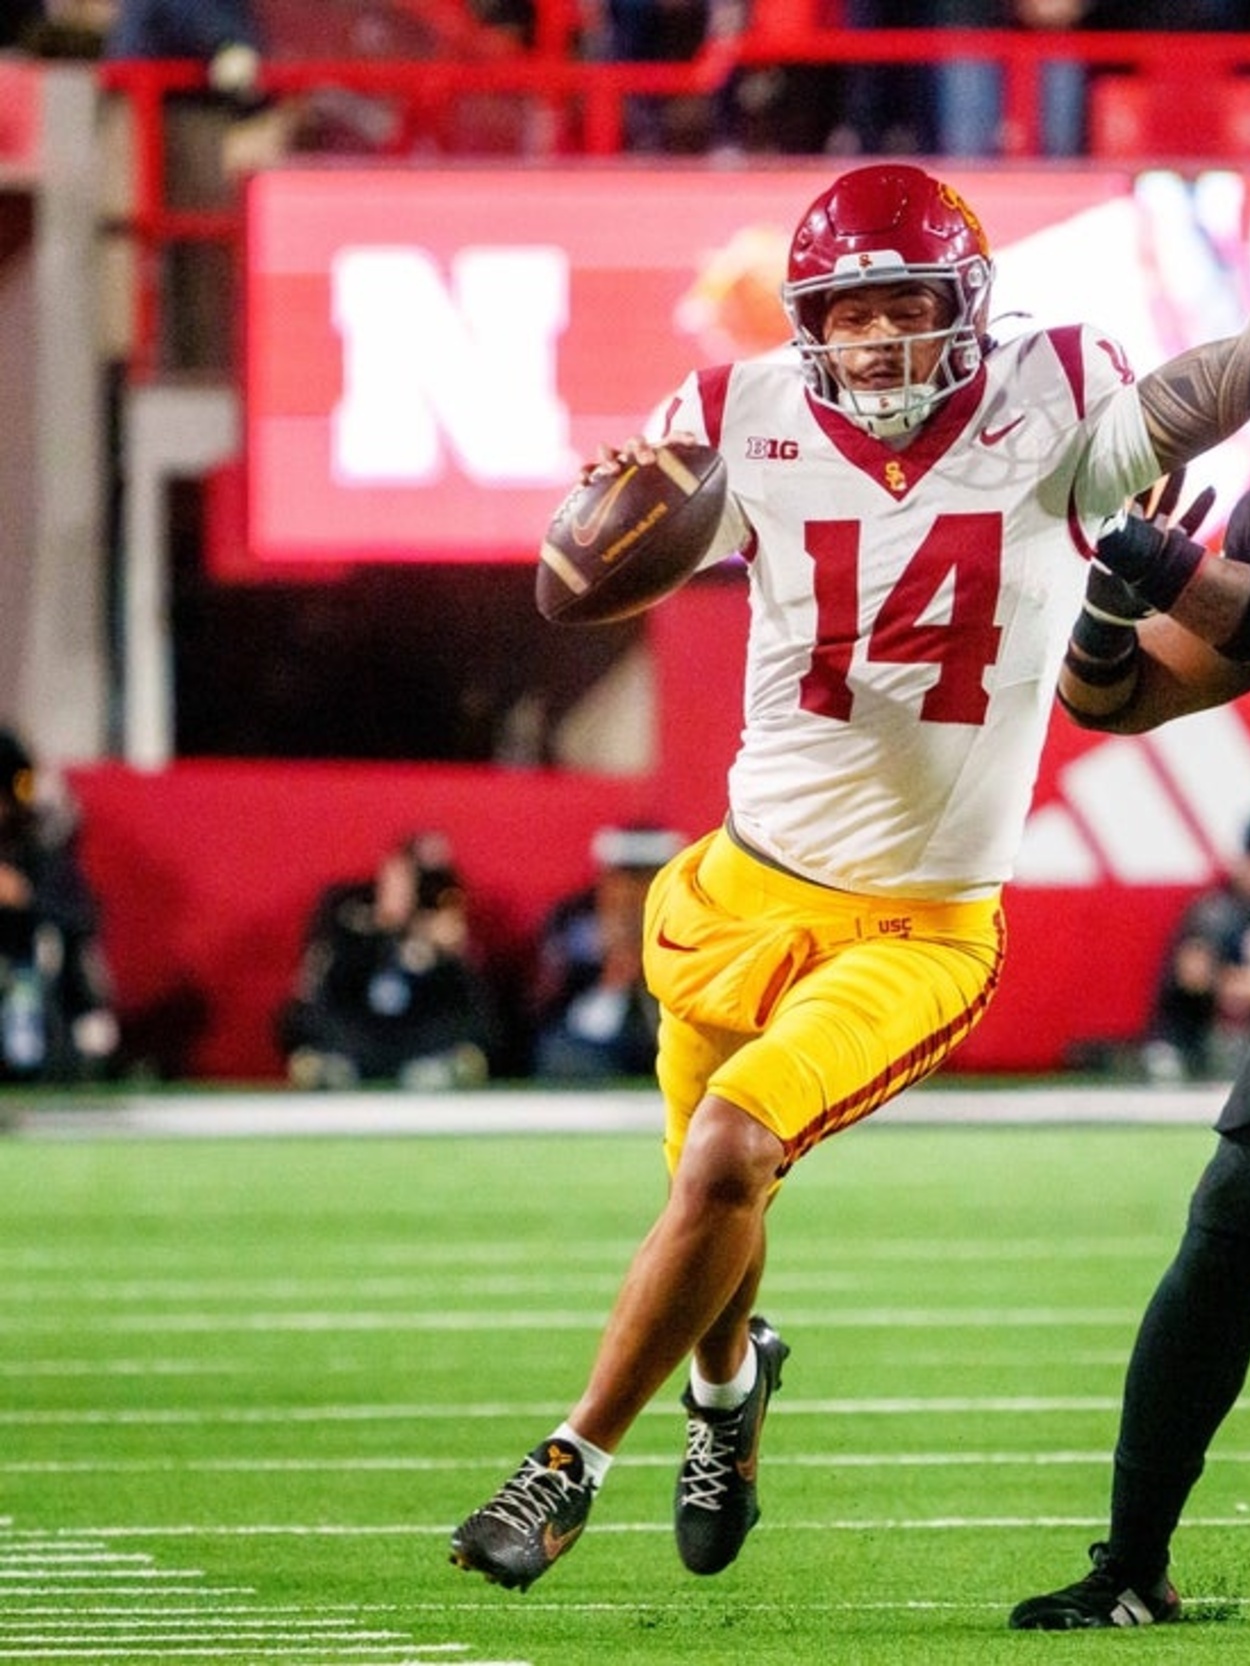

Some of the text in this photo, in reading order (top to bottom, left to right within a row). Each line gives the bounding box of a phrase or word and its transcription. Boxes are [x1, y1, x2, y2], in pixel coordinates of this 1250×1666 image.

[333, 247, 571, 485] N
[800, 511, 1003, 725] 14
[879, 917, 912, 934] USC
